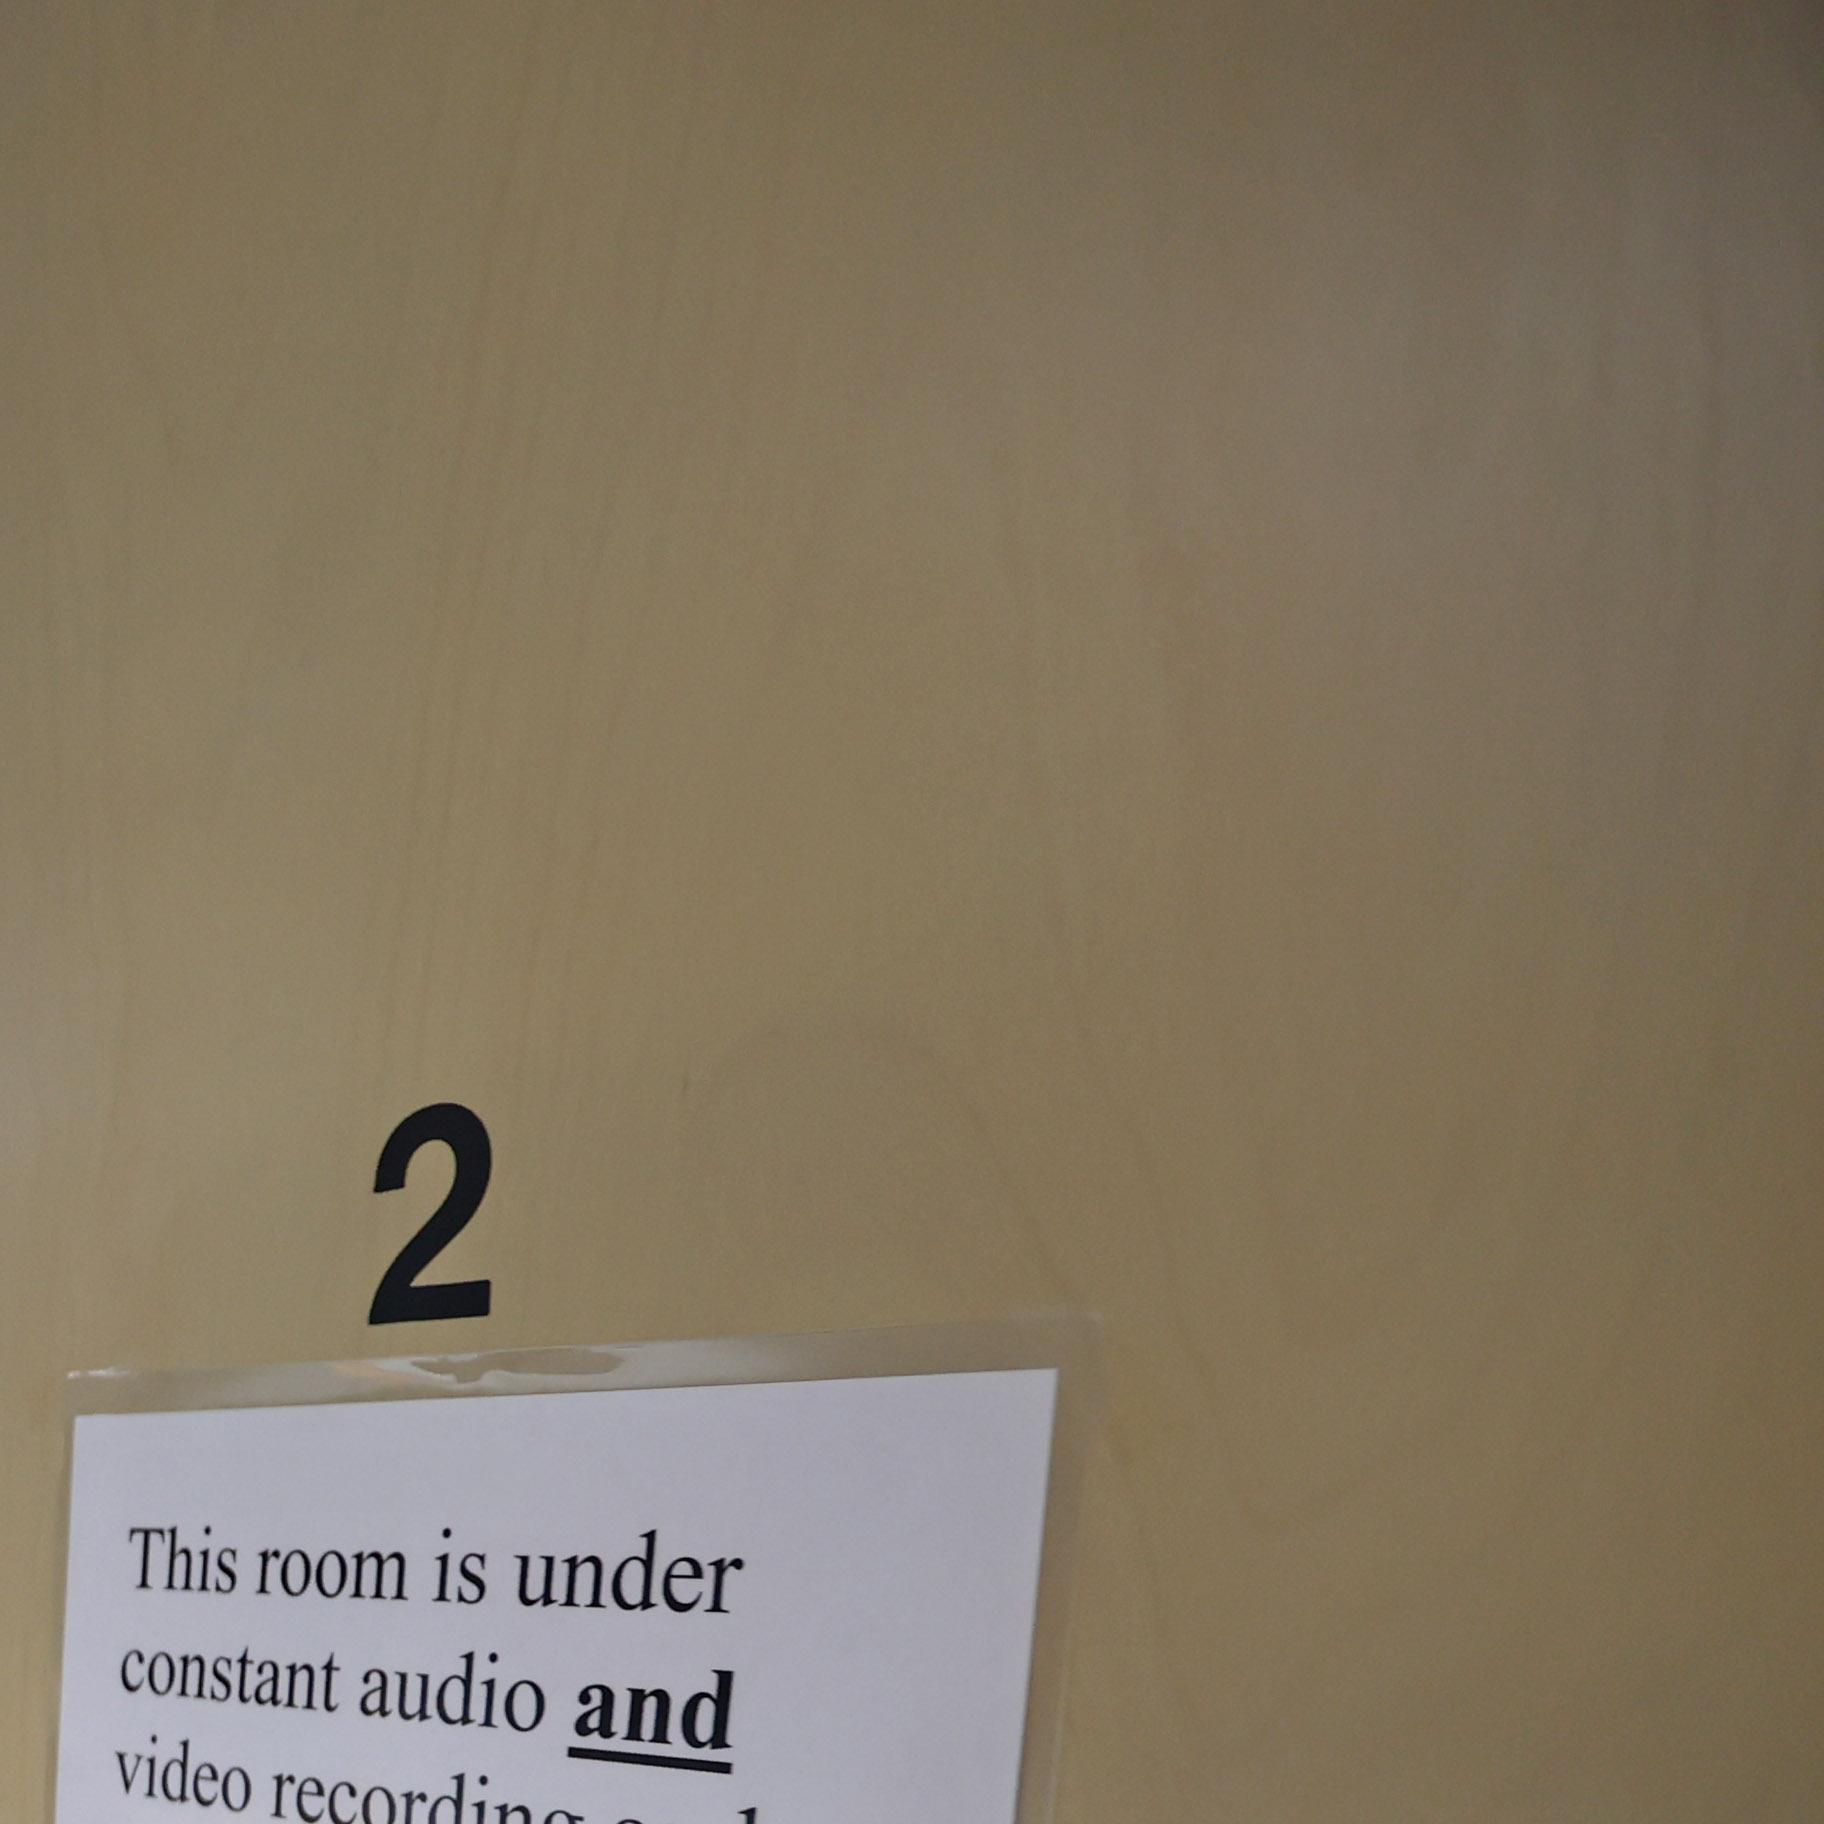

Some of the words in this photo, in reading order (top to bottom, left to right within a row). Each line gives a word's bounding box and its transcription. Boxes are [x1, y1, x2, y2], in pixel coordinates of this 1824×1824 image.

[366, 1101, 495, 1328] 2
[128, 1525, 238, 1595] This
[254, 1548, 408, 1603] room
[431, 1526, 487, 1606] is
[514, 1529, 746, 1615] under
[119, 1644, 342, 1714] constant
[358, 1650, 547, 1734] audio
[573, 1668, 735, 1751] and
[114, 1735, 253, 1813] video
